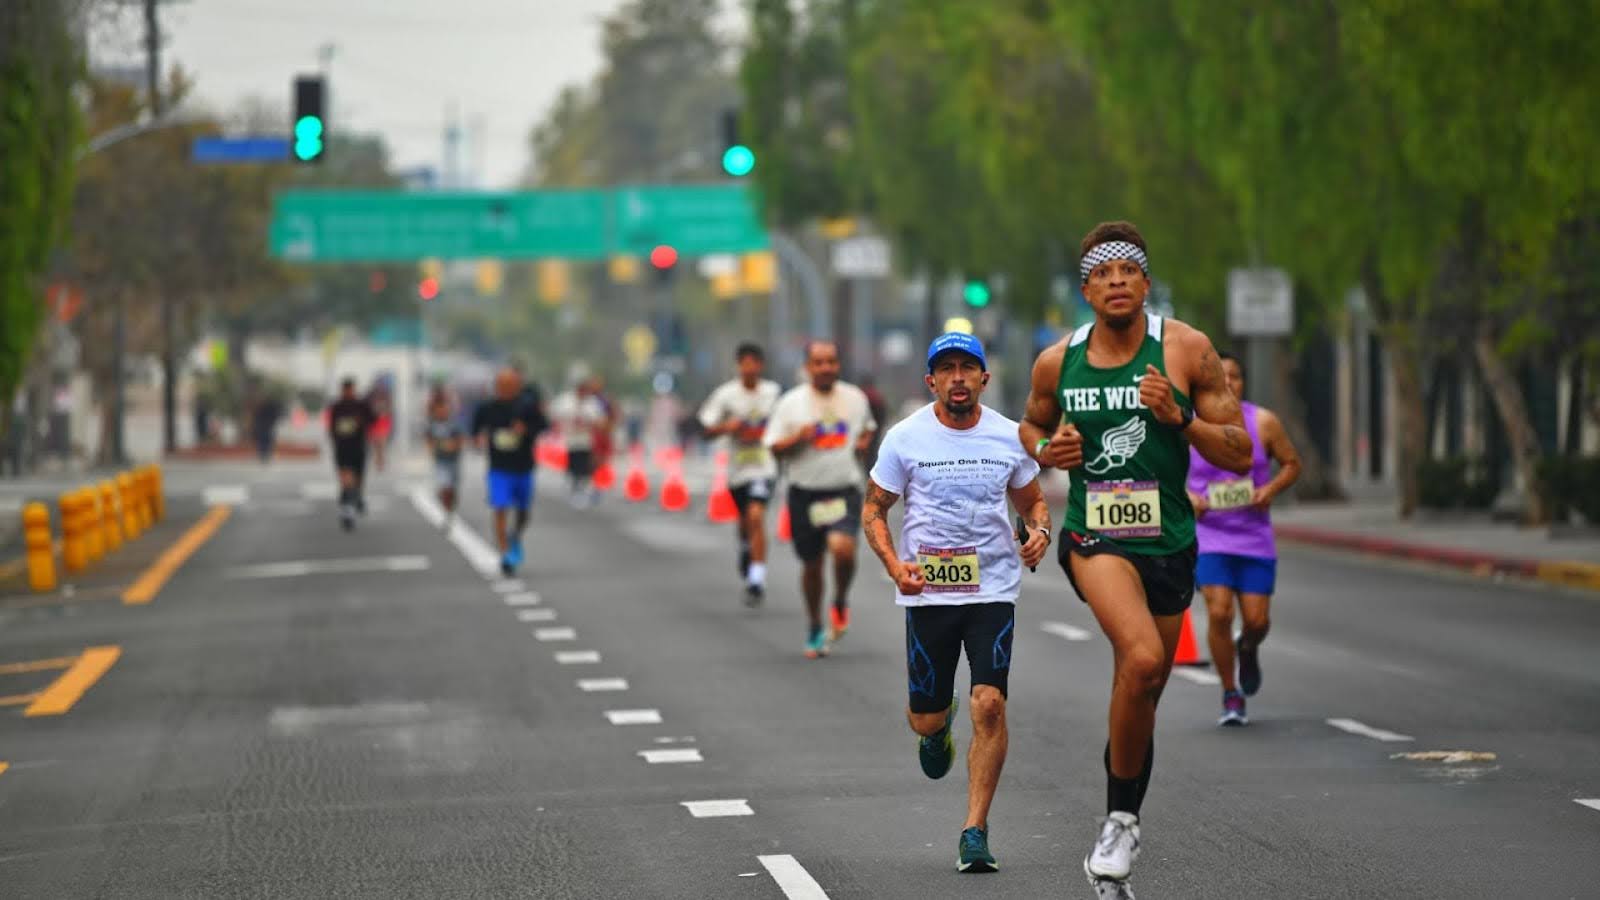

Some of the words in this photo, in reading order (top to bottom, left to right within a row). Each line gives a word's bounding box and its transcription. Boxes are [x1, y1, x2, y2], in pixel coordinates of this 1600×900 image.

[1063, 387, 1101, 412] THE
[918, 460, 955, 469] Square
[981, 458, 1009, 468] Dining
[1095, 502, 1152, 526] 1098
[924, 564, 972, 583] 3403
